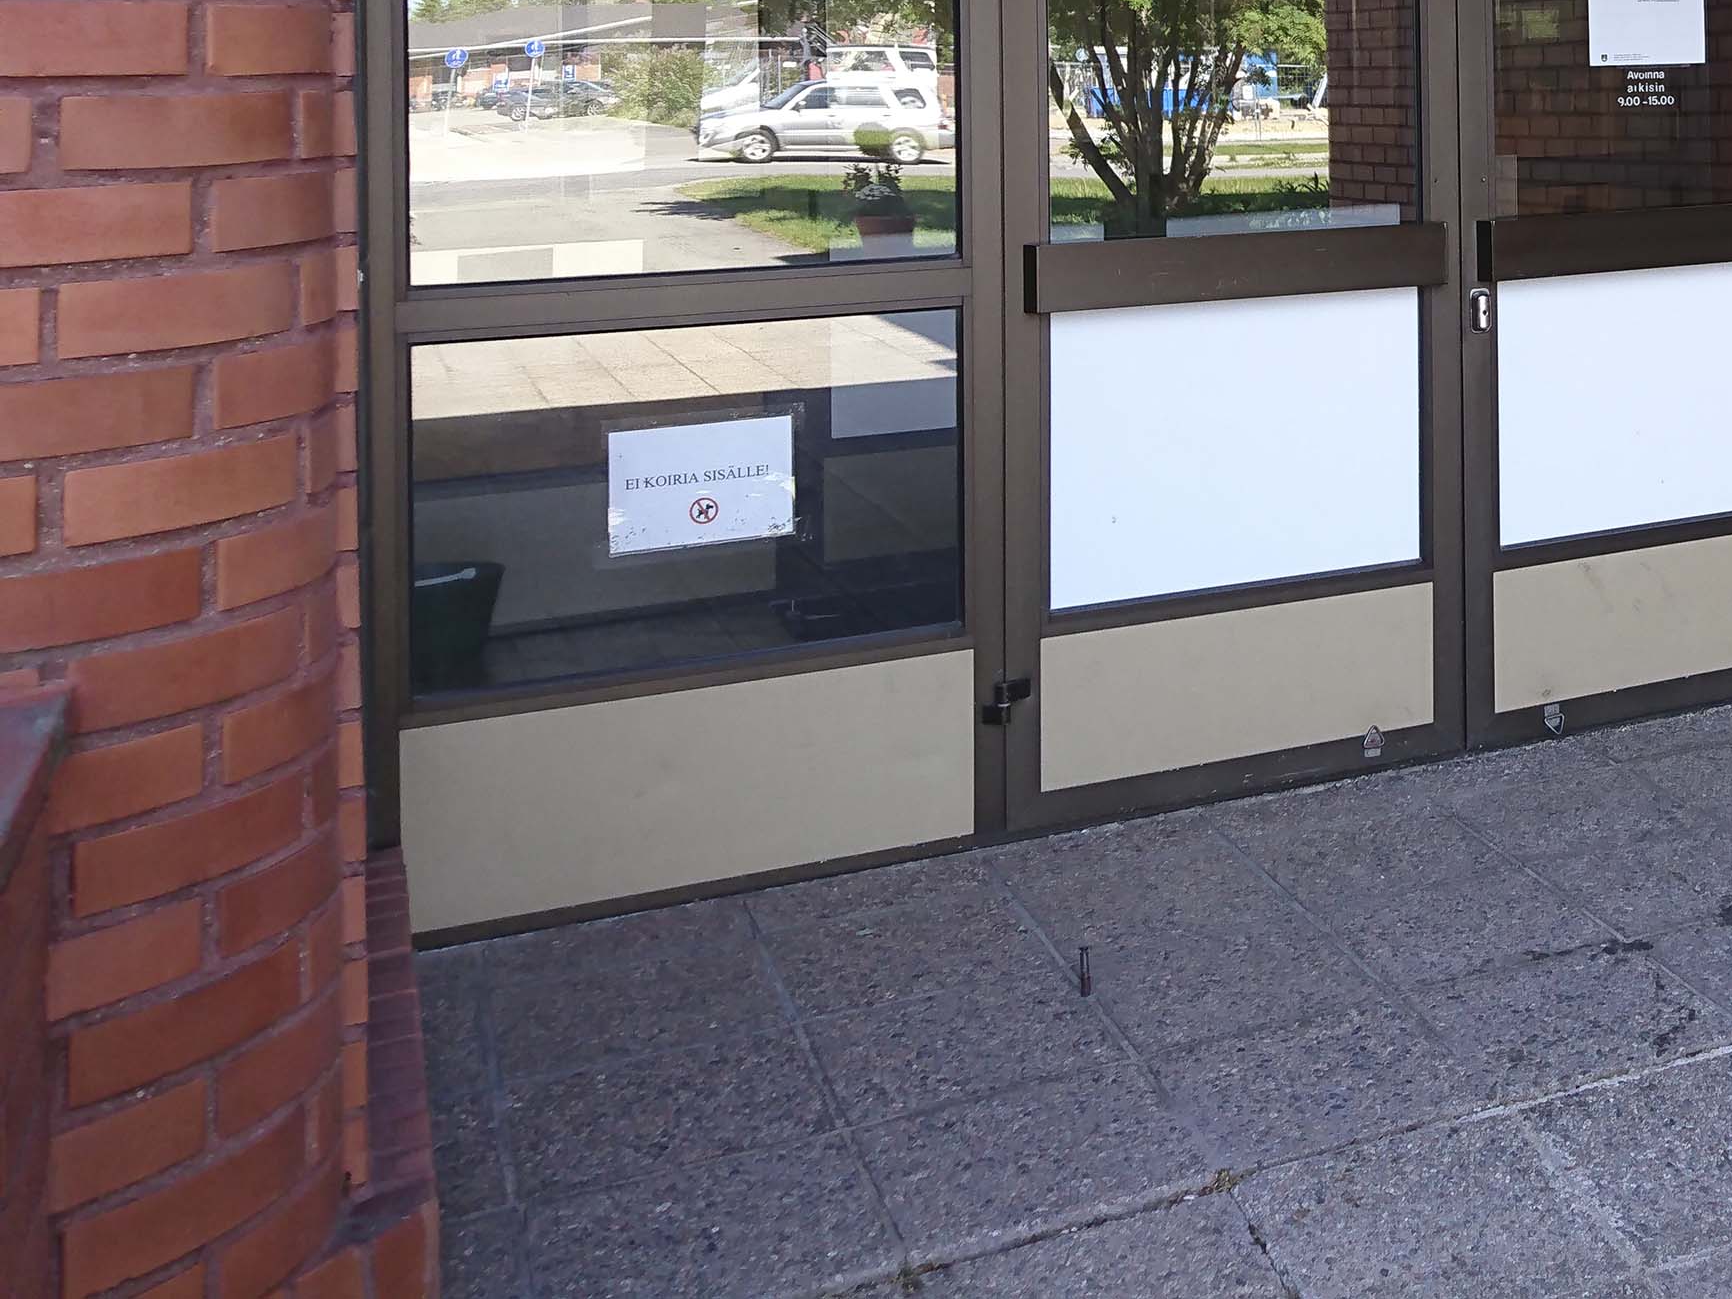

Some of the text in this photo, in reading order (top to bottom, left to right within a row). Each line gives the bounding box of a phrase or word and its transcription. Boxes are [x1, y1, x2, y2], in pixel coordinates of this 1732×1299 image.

[1627, 70, 1665, 80] Avoinna
[1617, 96, 1641, 107] 9.00
[625, 464, 769, 491] EI KOIRIA SISÄLLE!
